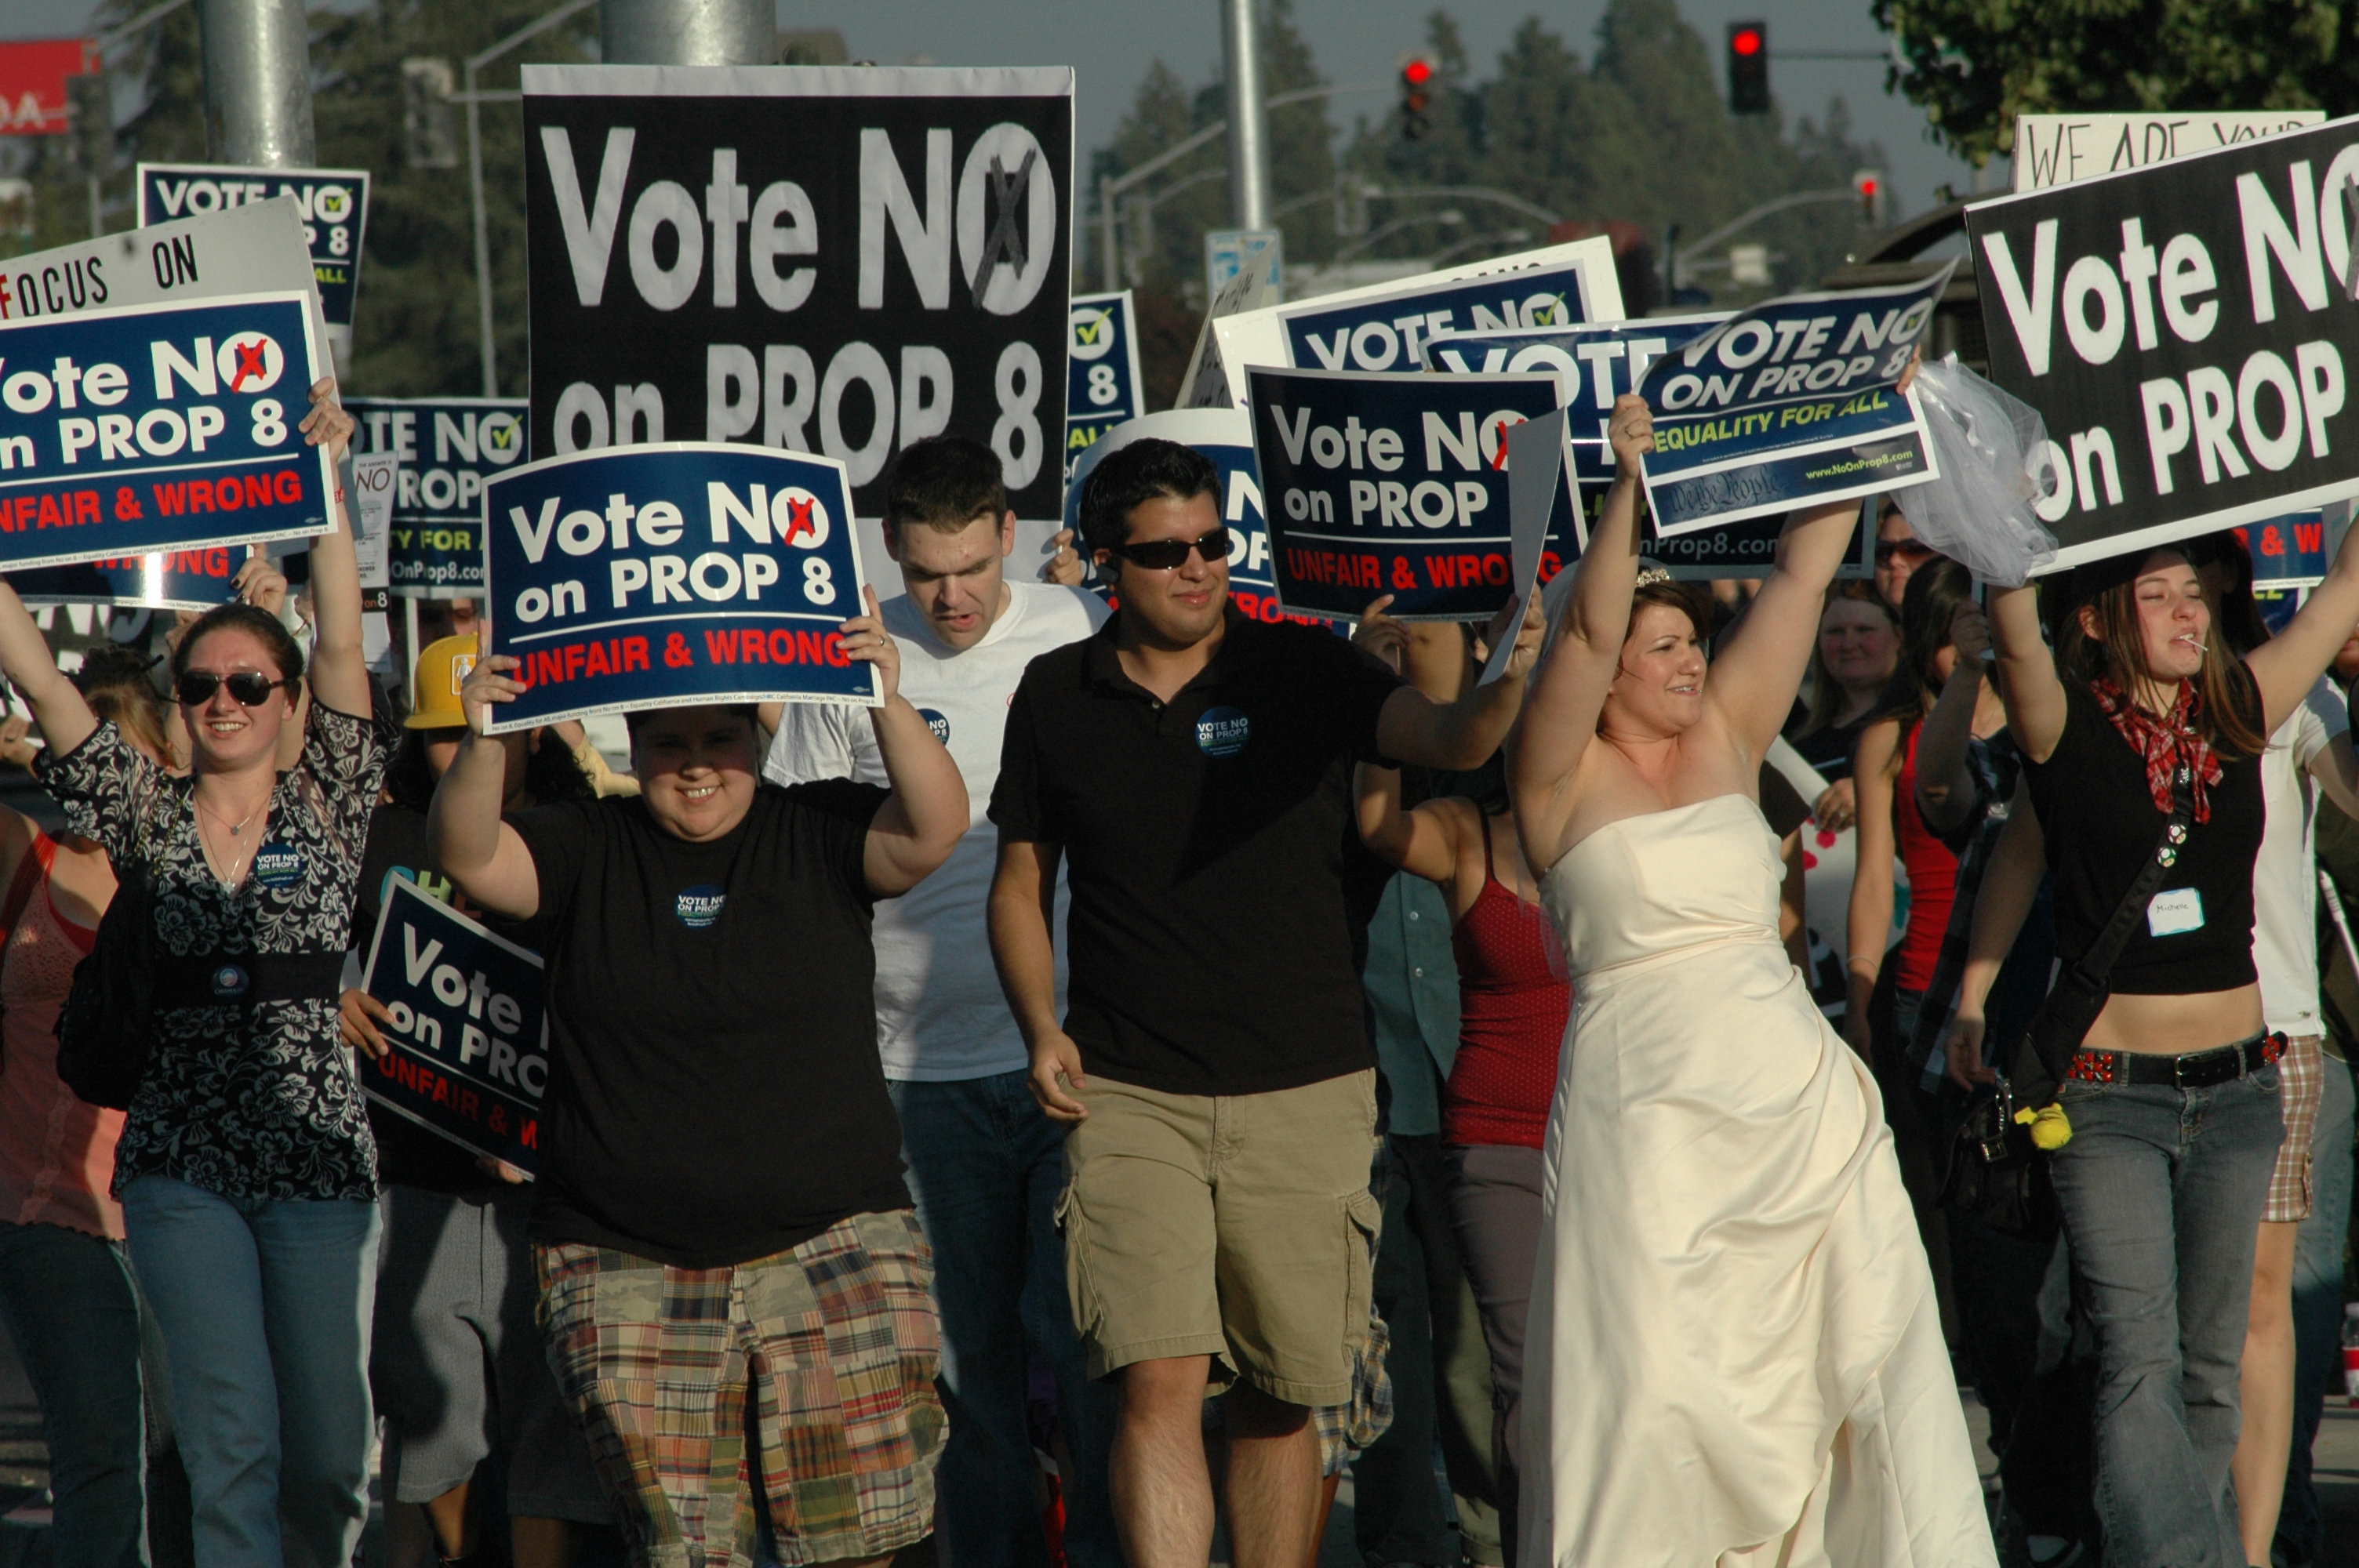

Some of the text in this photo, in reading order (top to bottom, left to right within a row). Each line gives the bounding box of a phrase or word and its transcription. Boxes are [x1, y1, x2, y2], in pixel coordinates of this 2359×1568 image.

[279, 184, 354, 224] NO
[540, 122, 1057, 315] Vote NO
[151, 234, 199, 289] ON
[329, 225, 350, 257] 8
[1470, 292, 1568, 331] NO
[1982, 216, 2219, 377] Vote
[1684, 296, 1933, 370] VOTE NO
[0, 331, 284, 414] ote NO
[1088, 364, 1118, 406] 8
[1661, 343, 1913, 411] ON PROP 8
[0, 398, 288, 470] n PROP 8
[348, 412, 523, 465] TE NO
[553, 341, 1044, 491] on PROP 8
[1270, 404, 1405, 472] Vote
[1654, 412, 1774, 453] EQUALITY
[1781, 401, 1836, 426] FOR
[1838, 390, 1889, 416] ALL
[2034, 339, 2346, 523] on PROP
[355, 466, 391, 492] NO
[396, 467, 482, 510] ROP
[1805, 449, 1914, 481] www.NoOnProp8.com
[0, 470, 303, 534] NFAIR & WRONG
[509, 481, 830, 564] Vote NO
[1284, 480, 1488, 529] on PROP
[420, 530, 471, 550] FOR
[514, 551, 837, 623] on PROP 8
[1287, 547, 1563, 590] UNFAIR & WROG
[364, 591, 388, 608] on 8
[512, 628, 852, 691] UNFAIR & WRONG
[929, 719, 947, 731] NO
[1198, 717, 1249, 733] VOTE NO
[1199, 731, 1213, 741] ON
[1216, 728, 1242, 739] PROP
[256, 853, 299, 863] VOTE NO
[678, 894, 727, 906] VOTE NO
[678, 903, 720, 913] ON PROP
[403, 921, 522, 1035] Vote
[387, 1000, 548, 1098] on PRO
[377, 1052, 479, 1123] UNFAIR
